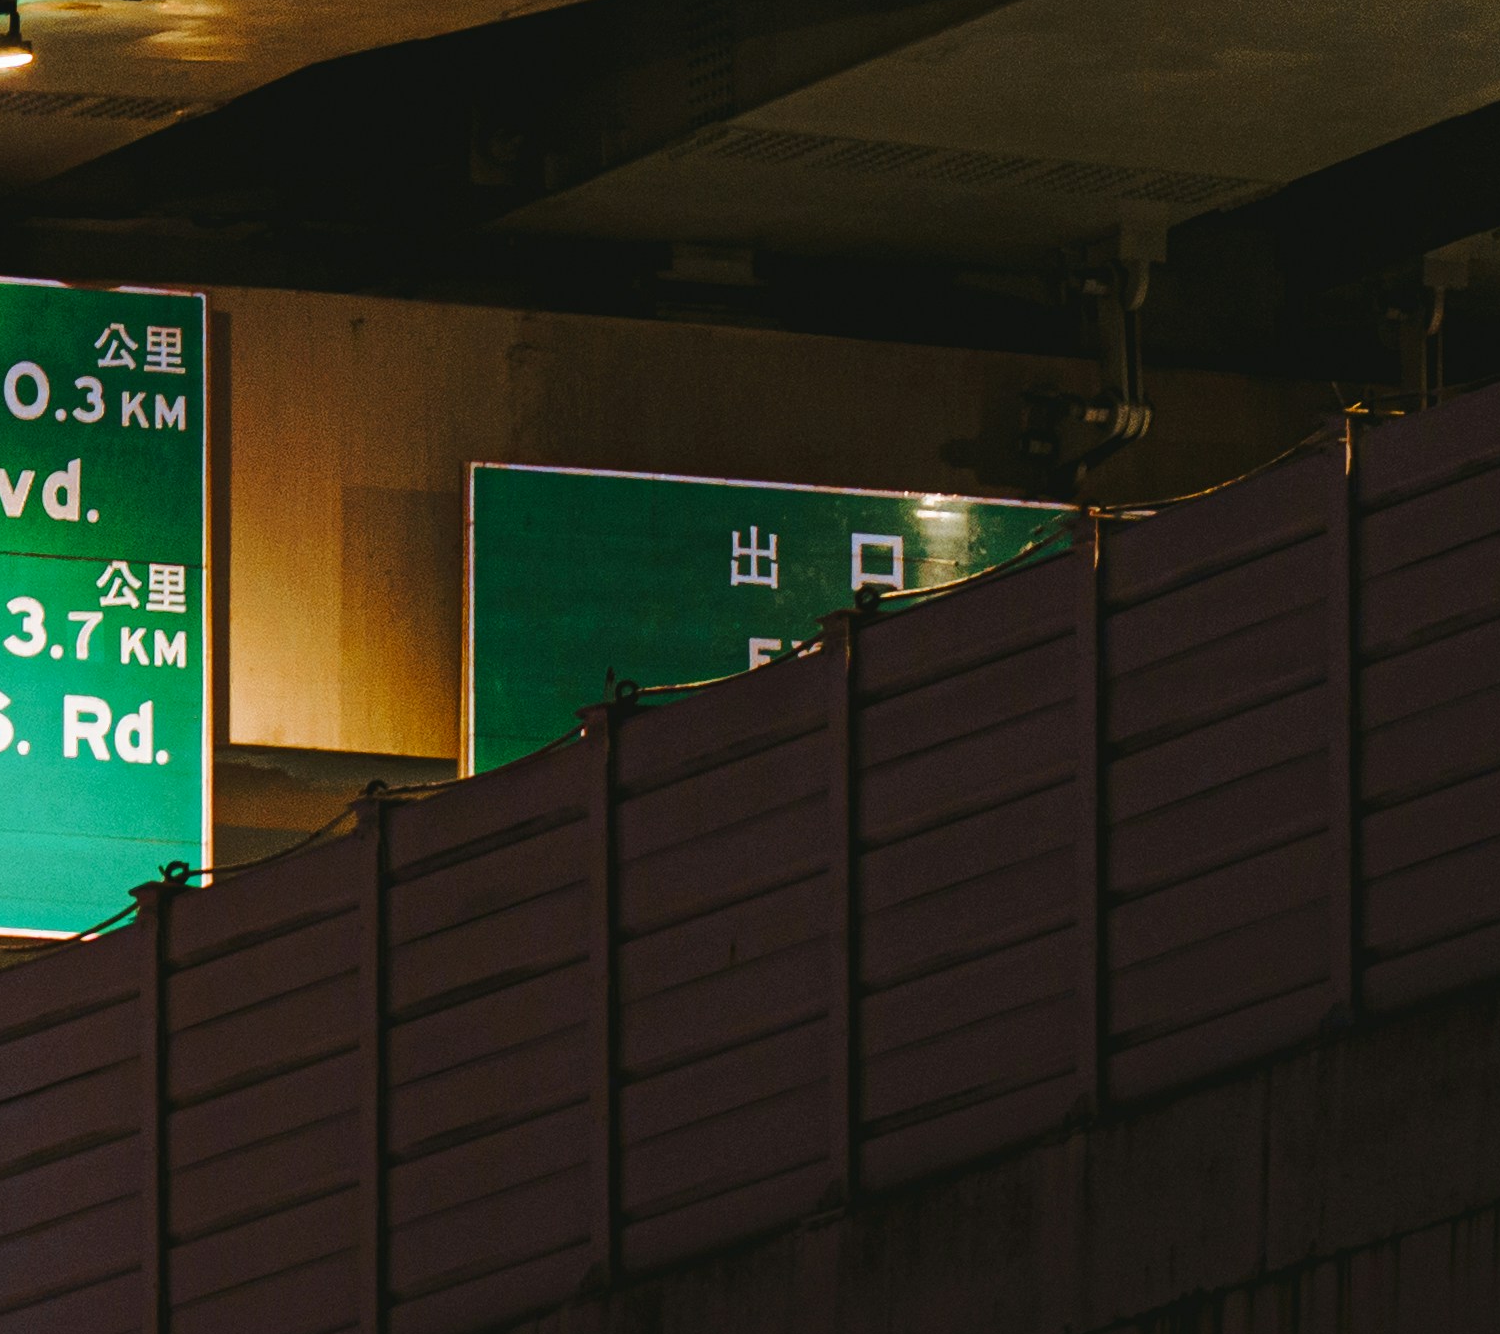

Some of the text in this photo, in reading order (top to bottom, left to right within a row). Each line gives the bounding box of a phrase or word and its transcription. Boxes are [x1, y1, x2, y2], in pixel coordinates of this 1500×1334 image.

[94, 322, 186, 374] 公里
[3, 360, 105, 423] 0.3
[121, 391, 187, 431] KM
[96, 560, 187, 614] 公里
[730, 525, 904, 591] 出口
[3, 596, 104, 660] 3.7
[120, 626, 187, 668] KM
[62, 694, 169, 765] Rd.
